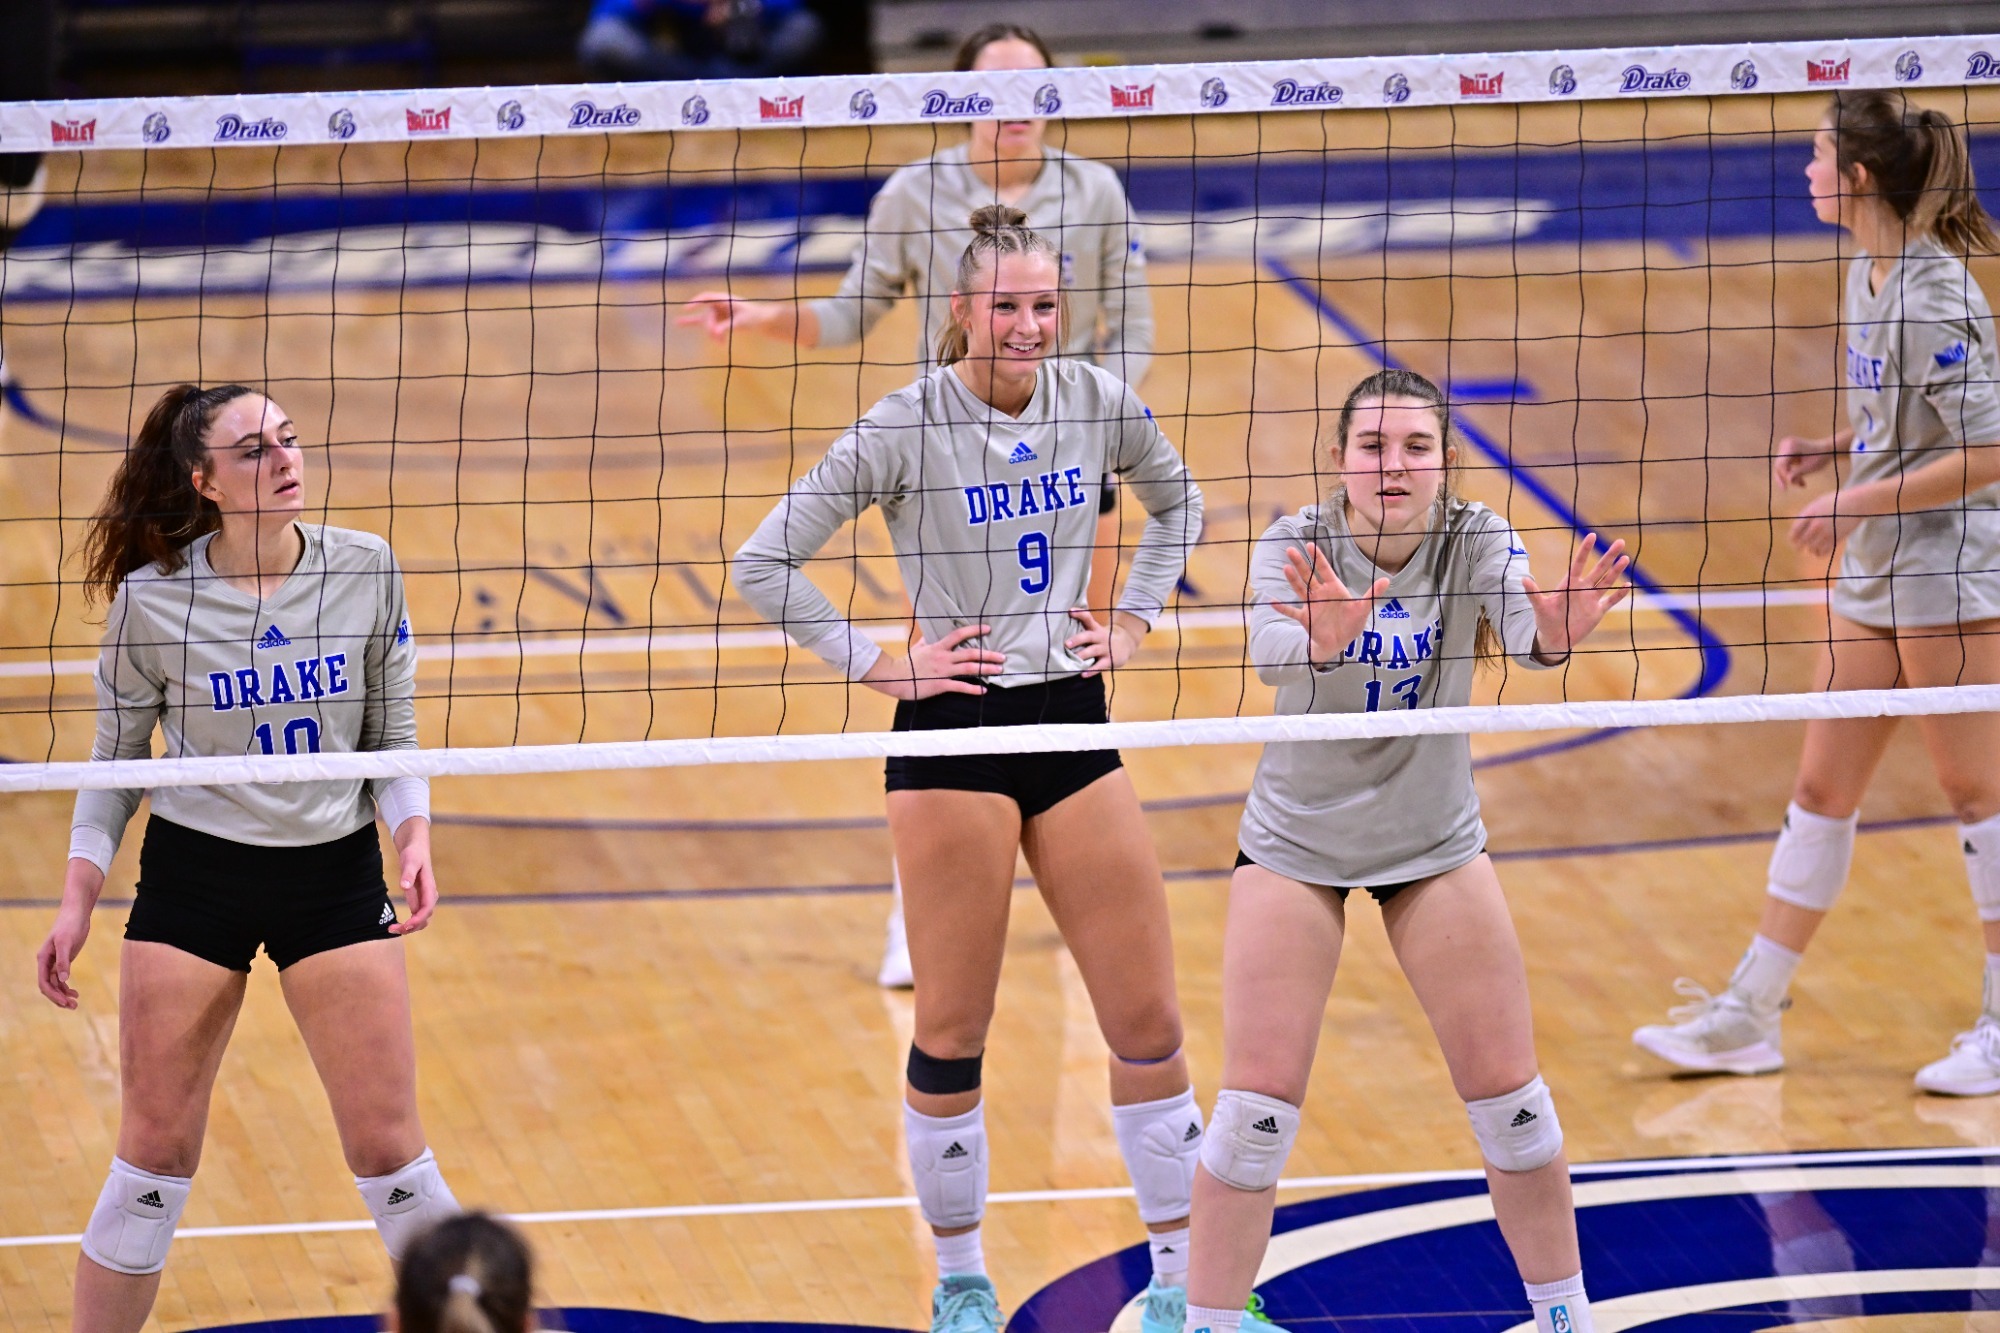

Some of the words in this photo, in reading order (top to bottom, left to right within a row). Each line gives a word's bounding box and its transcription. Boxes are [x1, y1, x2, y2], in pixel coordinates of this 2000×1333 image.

[1270, 78, 1343, 105] Drake
[1619, 64, 1691, 92] Drake
[568, 100, 641, 128] Drake
[920, 89, 993, 117] Drake
[214, 113, 287, 141] Drake
[1008, 452, 1038, 464] adidas
[964, 465, 1087, 526] DRAKE
[1016, 530, 1050, 596] 9
[1379, 610, 1410, 619] adidas
[257, 637, 292, 649] adidas
[207, 652, 349, 712] DRAKE
[1510, 1114, 1537, 1127] adidas
[137, 1197, 164, 1209] adidas
[387, 1192, 414, 1206] adidas
